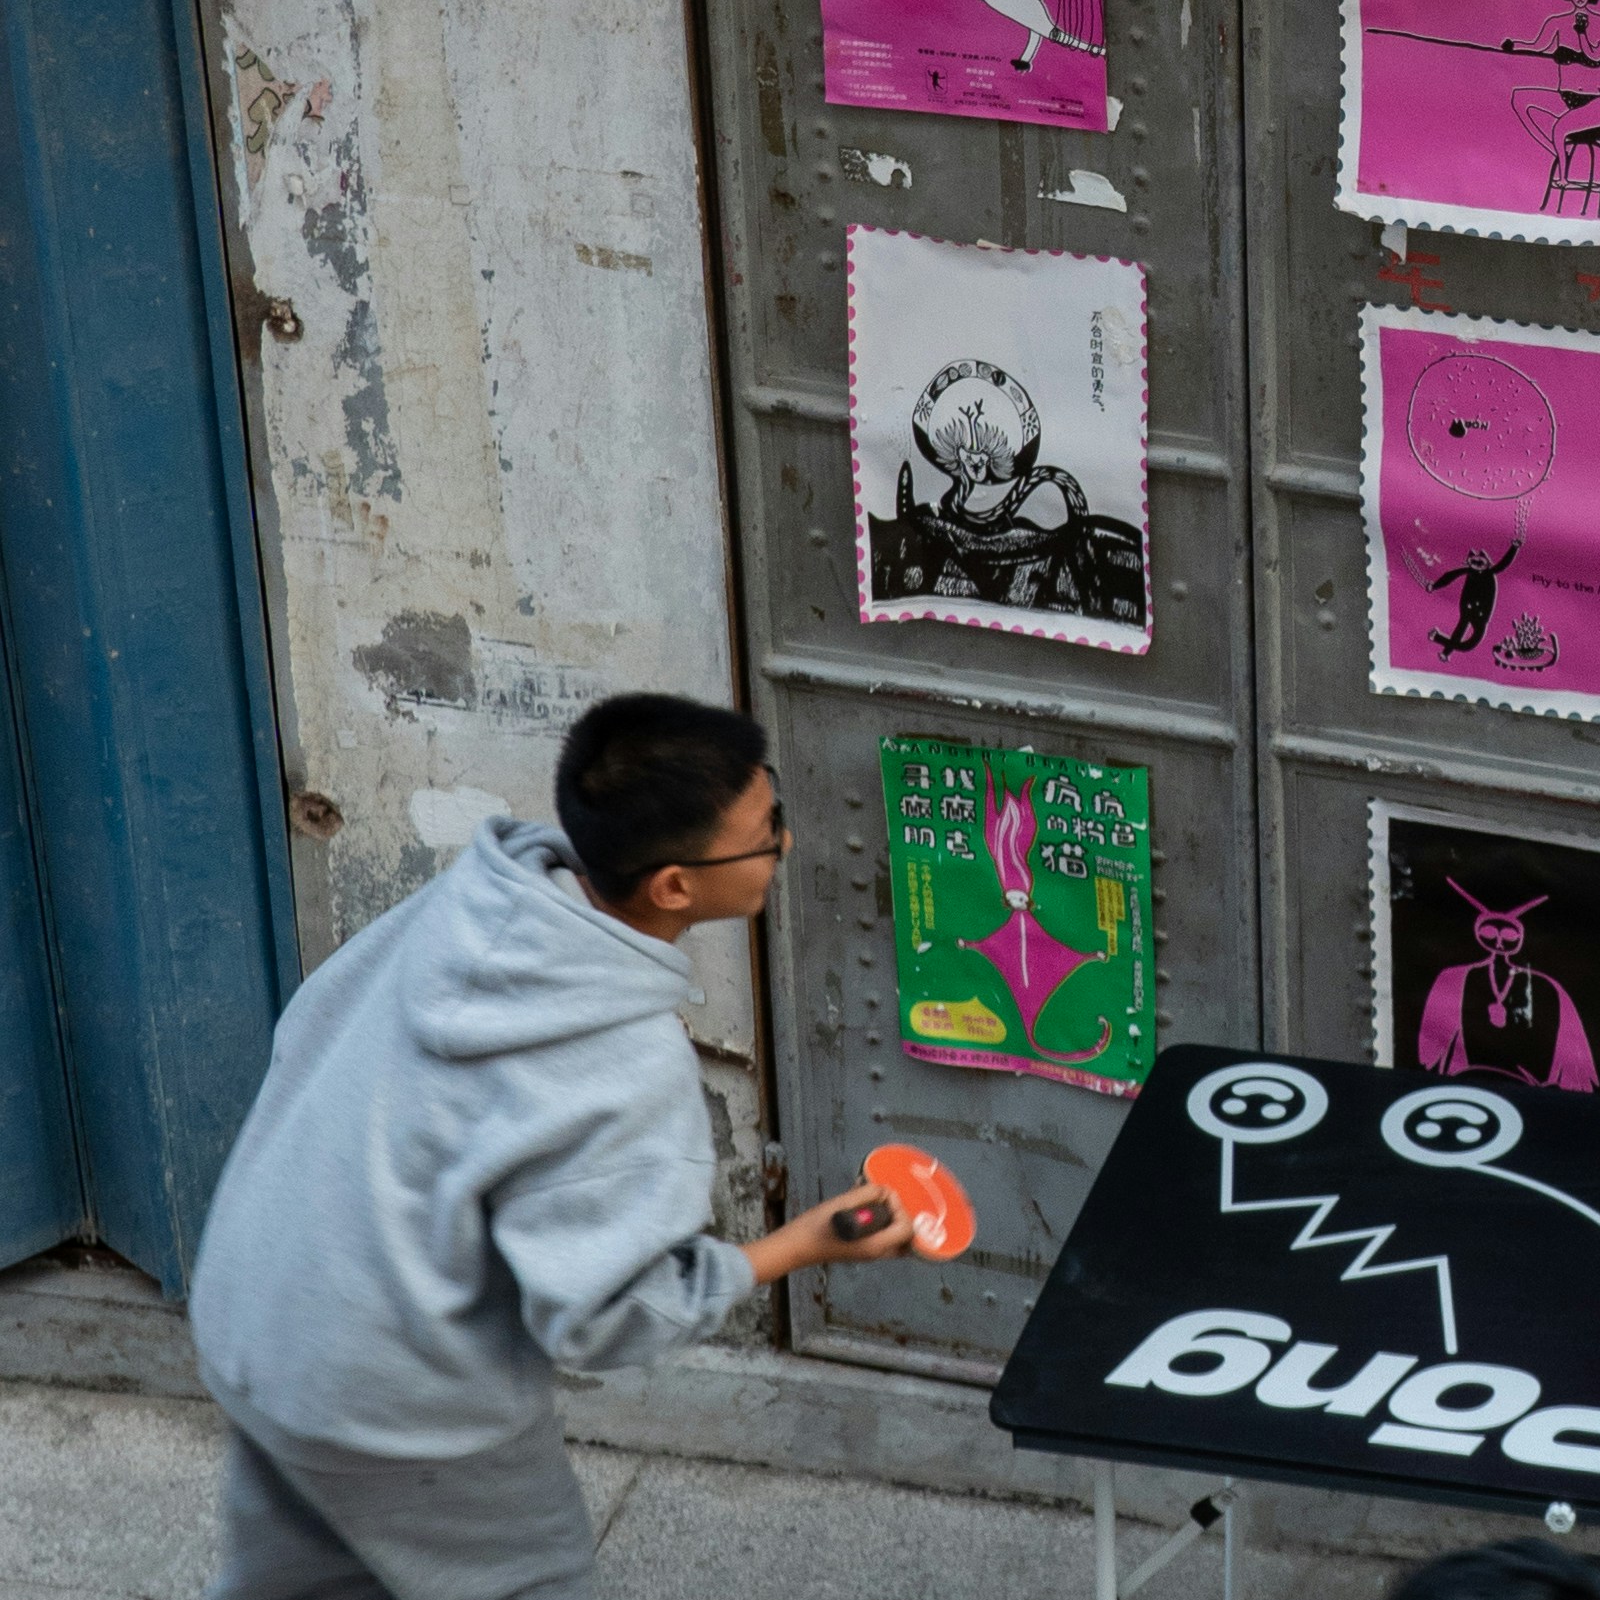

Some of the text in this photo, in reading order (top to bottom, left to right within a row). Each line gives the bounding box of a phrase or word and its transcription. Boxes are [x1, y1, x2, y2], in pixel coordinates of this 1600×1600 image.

[1532, 573, 1551, 589] Fly
[1556, 579, 1570, 590] to
[1574, 582, 1595, 594] the
[1041, 842, 1088, 880] 猫
